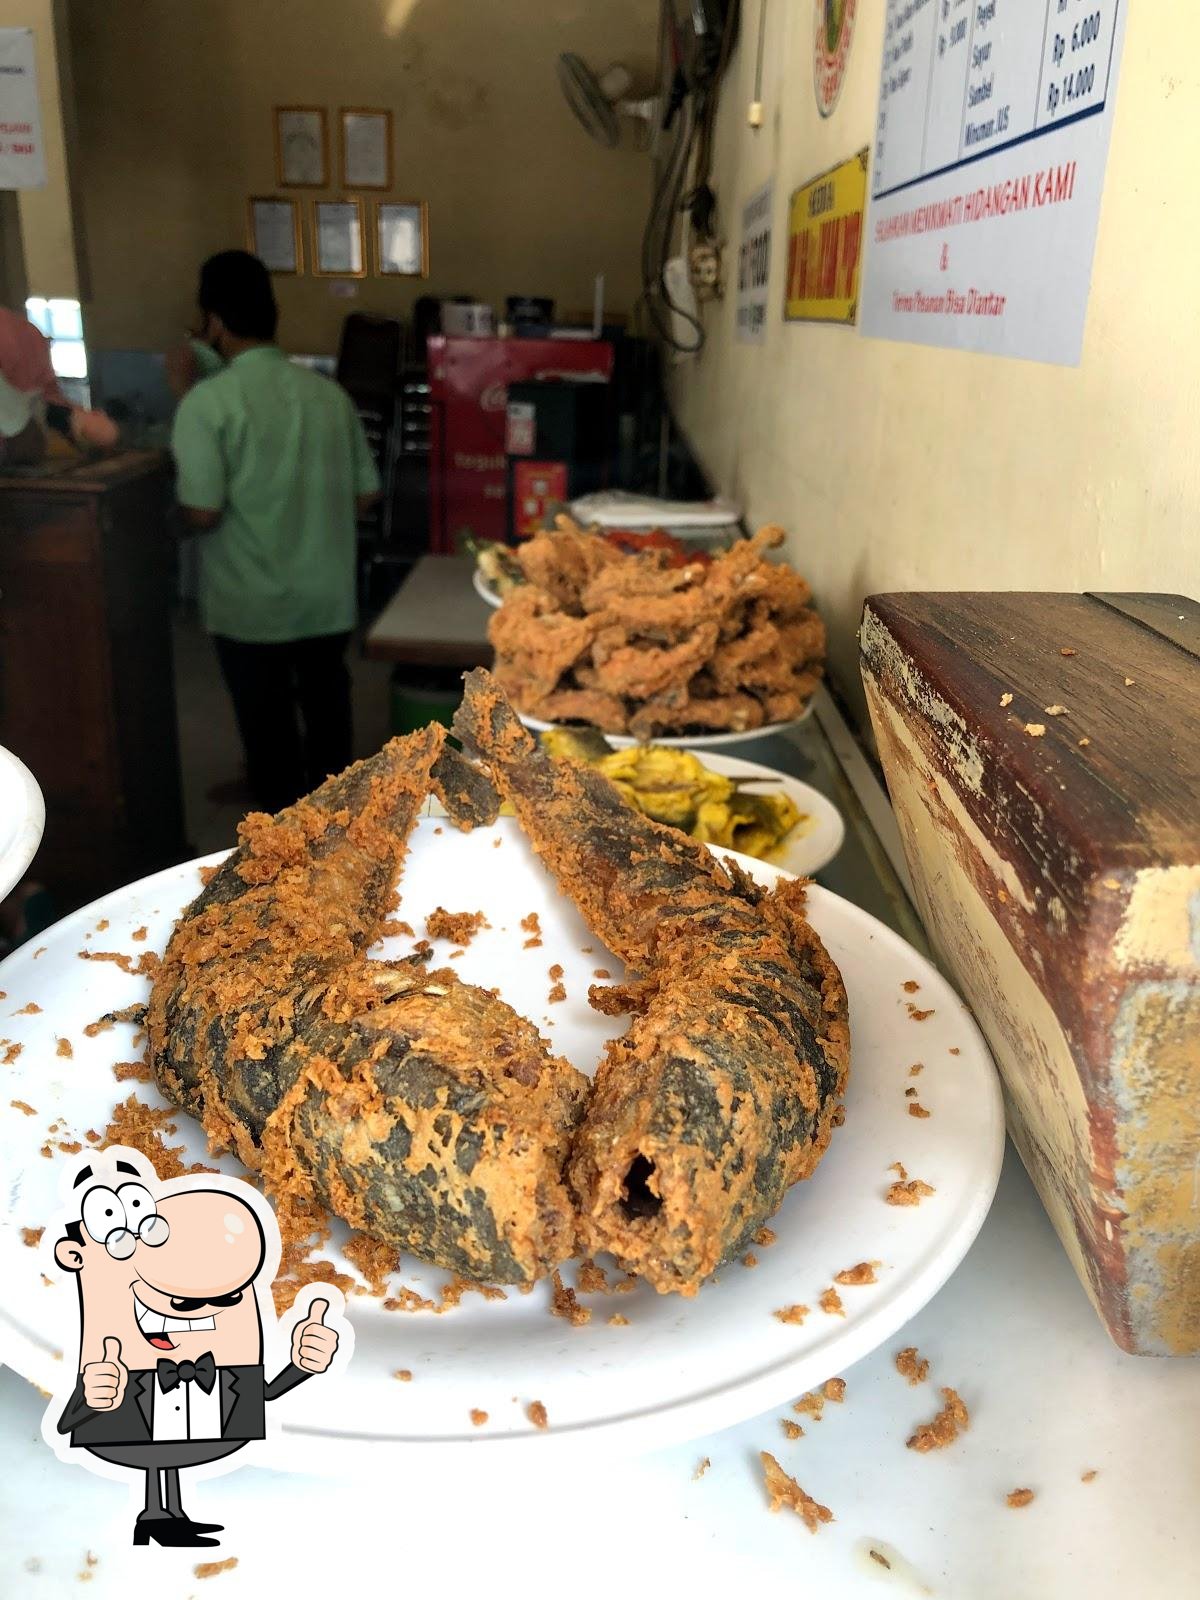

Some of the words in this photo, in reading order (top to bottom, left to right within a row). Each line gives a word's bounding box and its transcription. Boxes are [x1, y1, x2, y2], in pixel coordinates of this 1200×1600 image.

[1053, 33, 1065, 67] Rp
[1072, 11, 1100, 51] 6.000
[1047, 82, 1060, 117] Rp
[1062, 63, 1095, 105] 14.000
[963, 174, 1031, 224] HIDANGAN
[1032, 161, 1077, 207] KAMI
[966, 287, 1007, 316] Diantar
